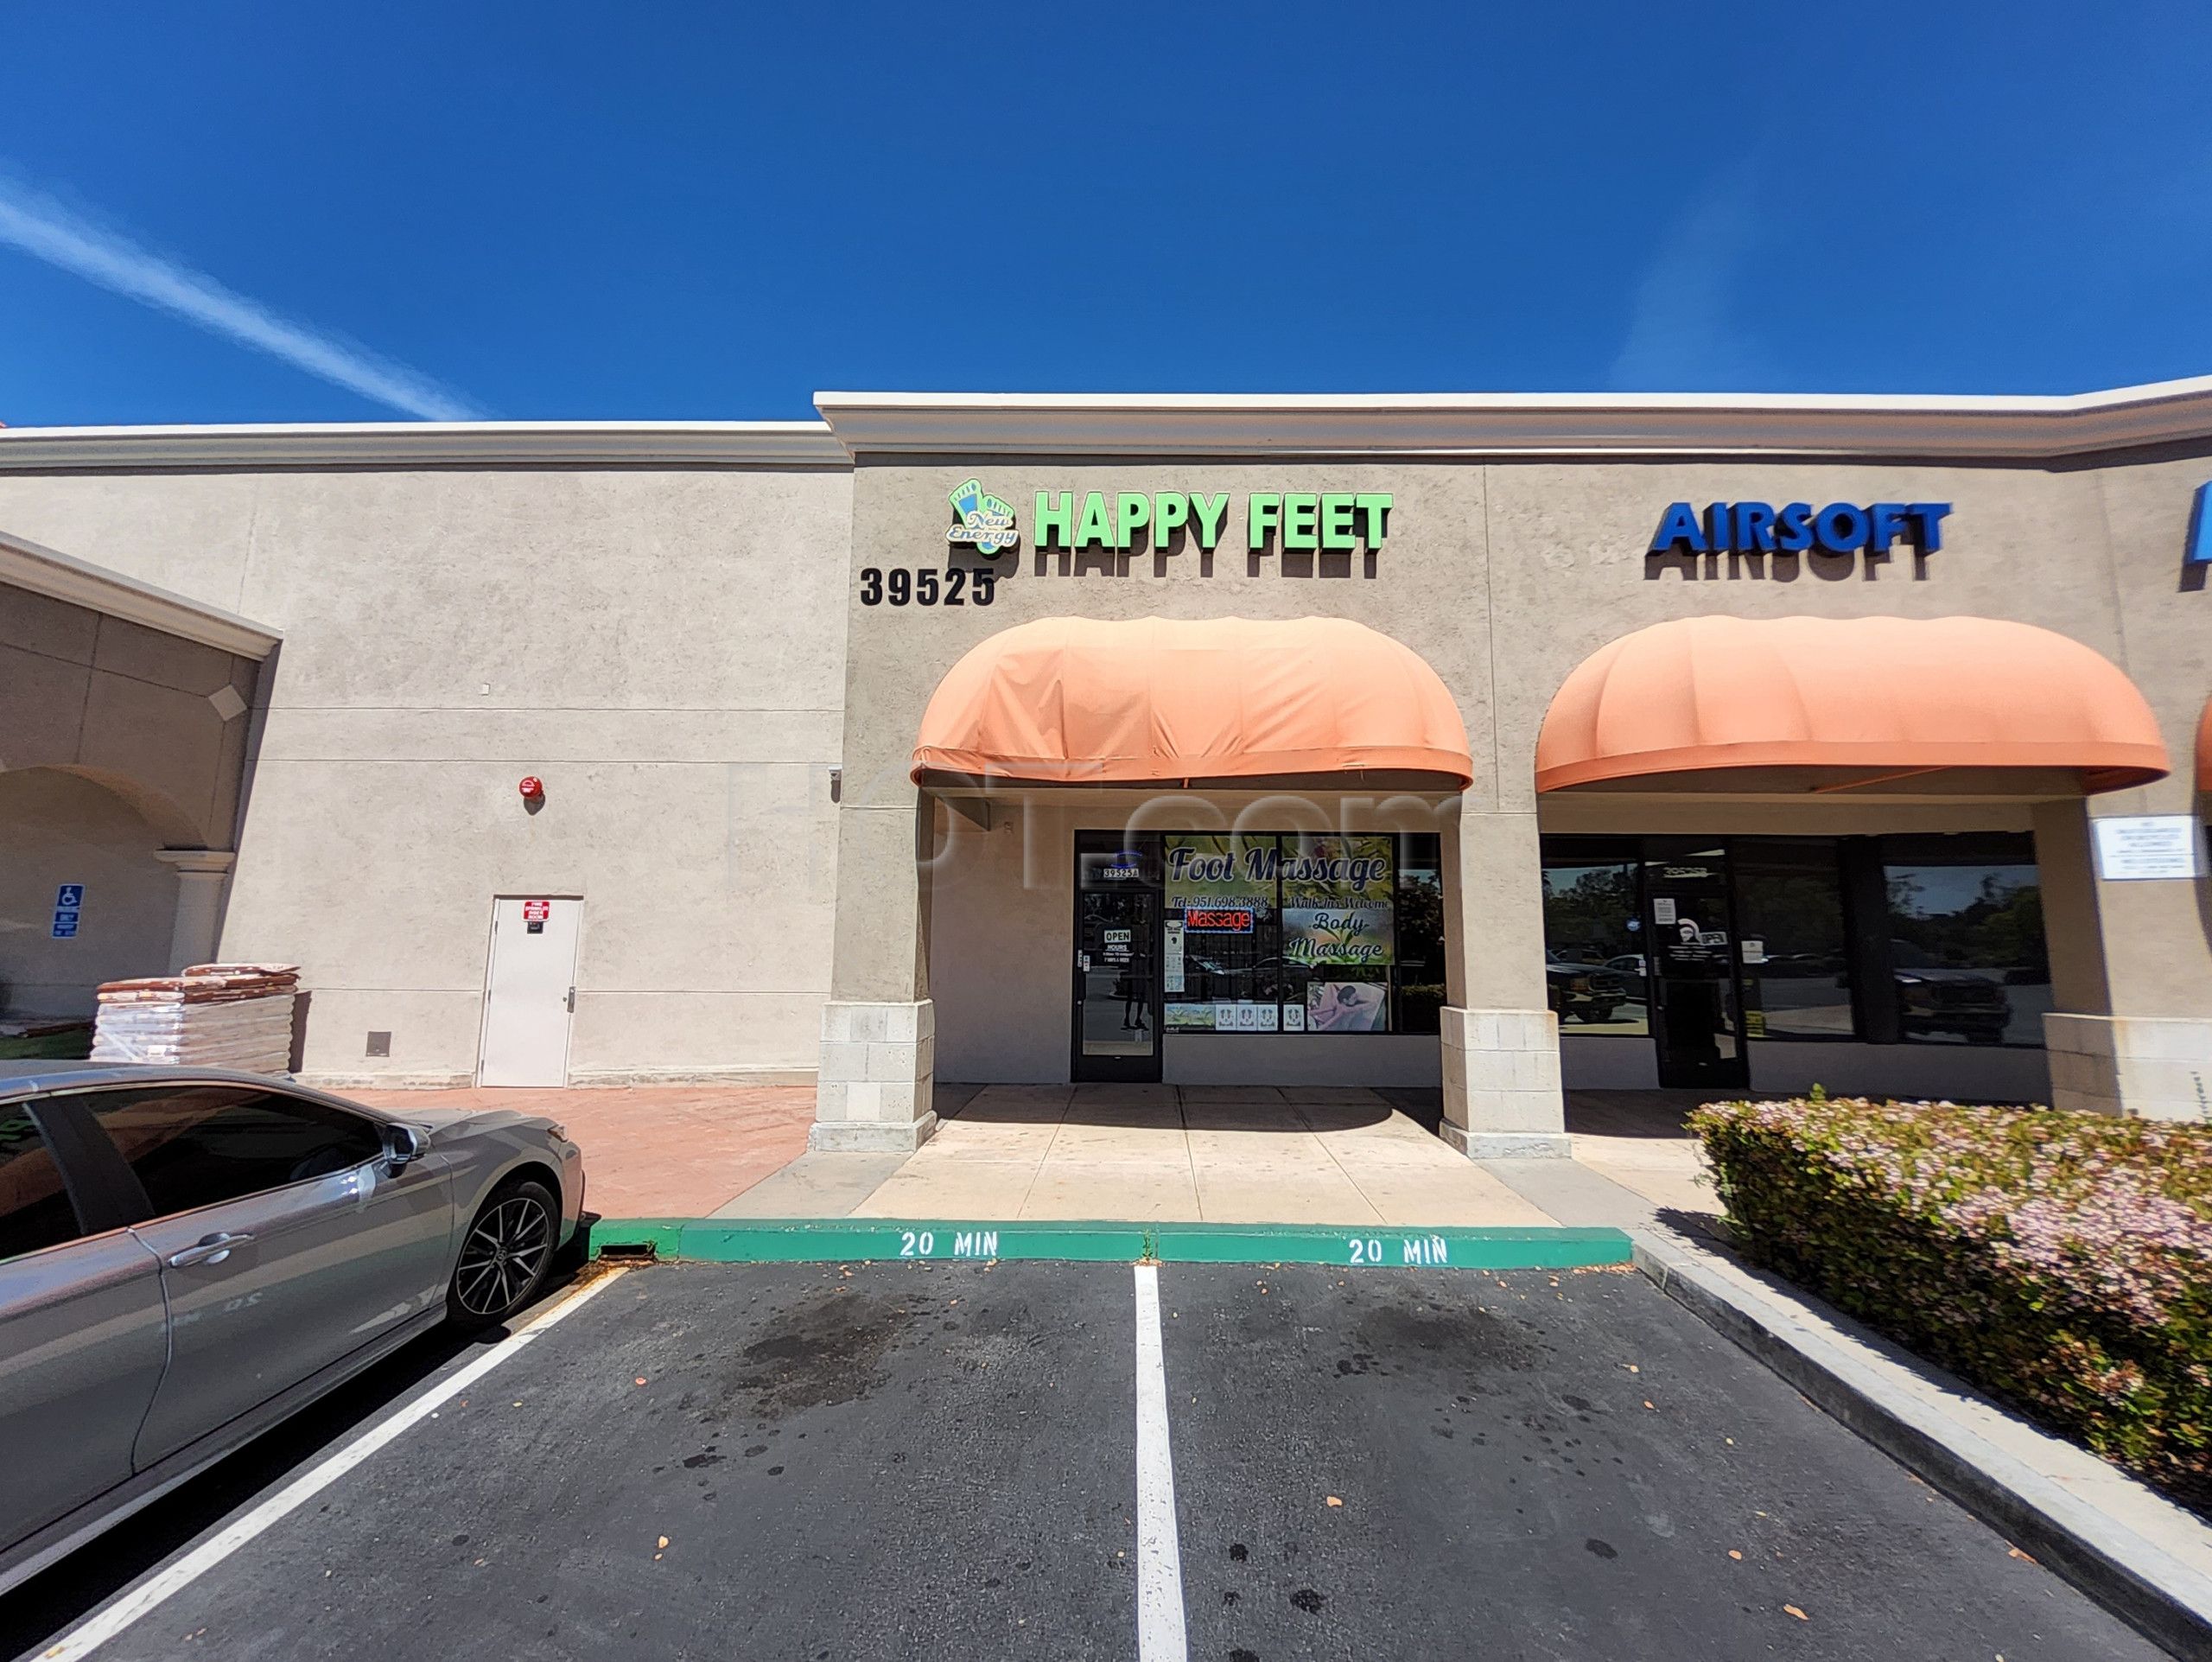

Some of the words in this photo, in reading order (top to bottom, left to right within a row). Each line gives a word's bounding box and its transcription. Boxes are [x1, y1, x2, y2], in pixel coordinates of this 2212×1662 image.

[967, 512, 1007, 530] New
[1034, 490, 1230, 551] HAPPY
[1248, 492, 1394, 551] FEET
[1647, 501, 1954, 556] AIRSOFT
[949, 525, 1016, 545] Energy
[861, 567, 995, 606] 39525
[1168, 847, 1235, 881] Foot
[1244, 848, 1385, 891] Massage
[1187, 910, 1249, 932] Massage
[1311, 913, 1370, 936] Body
[1106, 932, 1129, 941] OPEN
[1289, 939, 1382, 963] Massage
[899, 1232, 933, 1256] 20
[954, 1232, 997, 1257] MIN
[1349, 1239, 1382, 1264] 20
[1403, 1238, 1447, 1264] MIN
